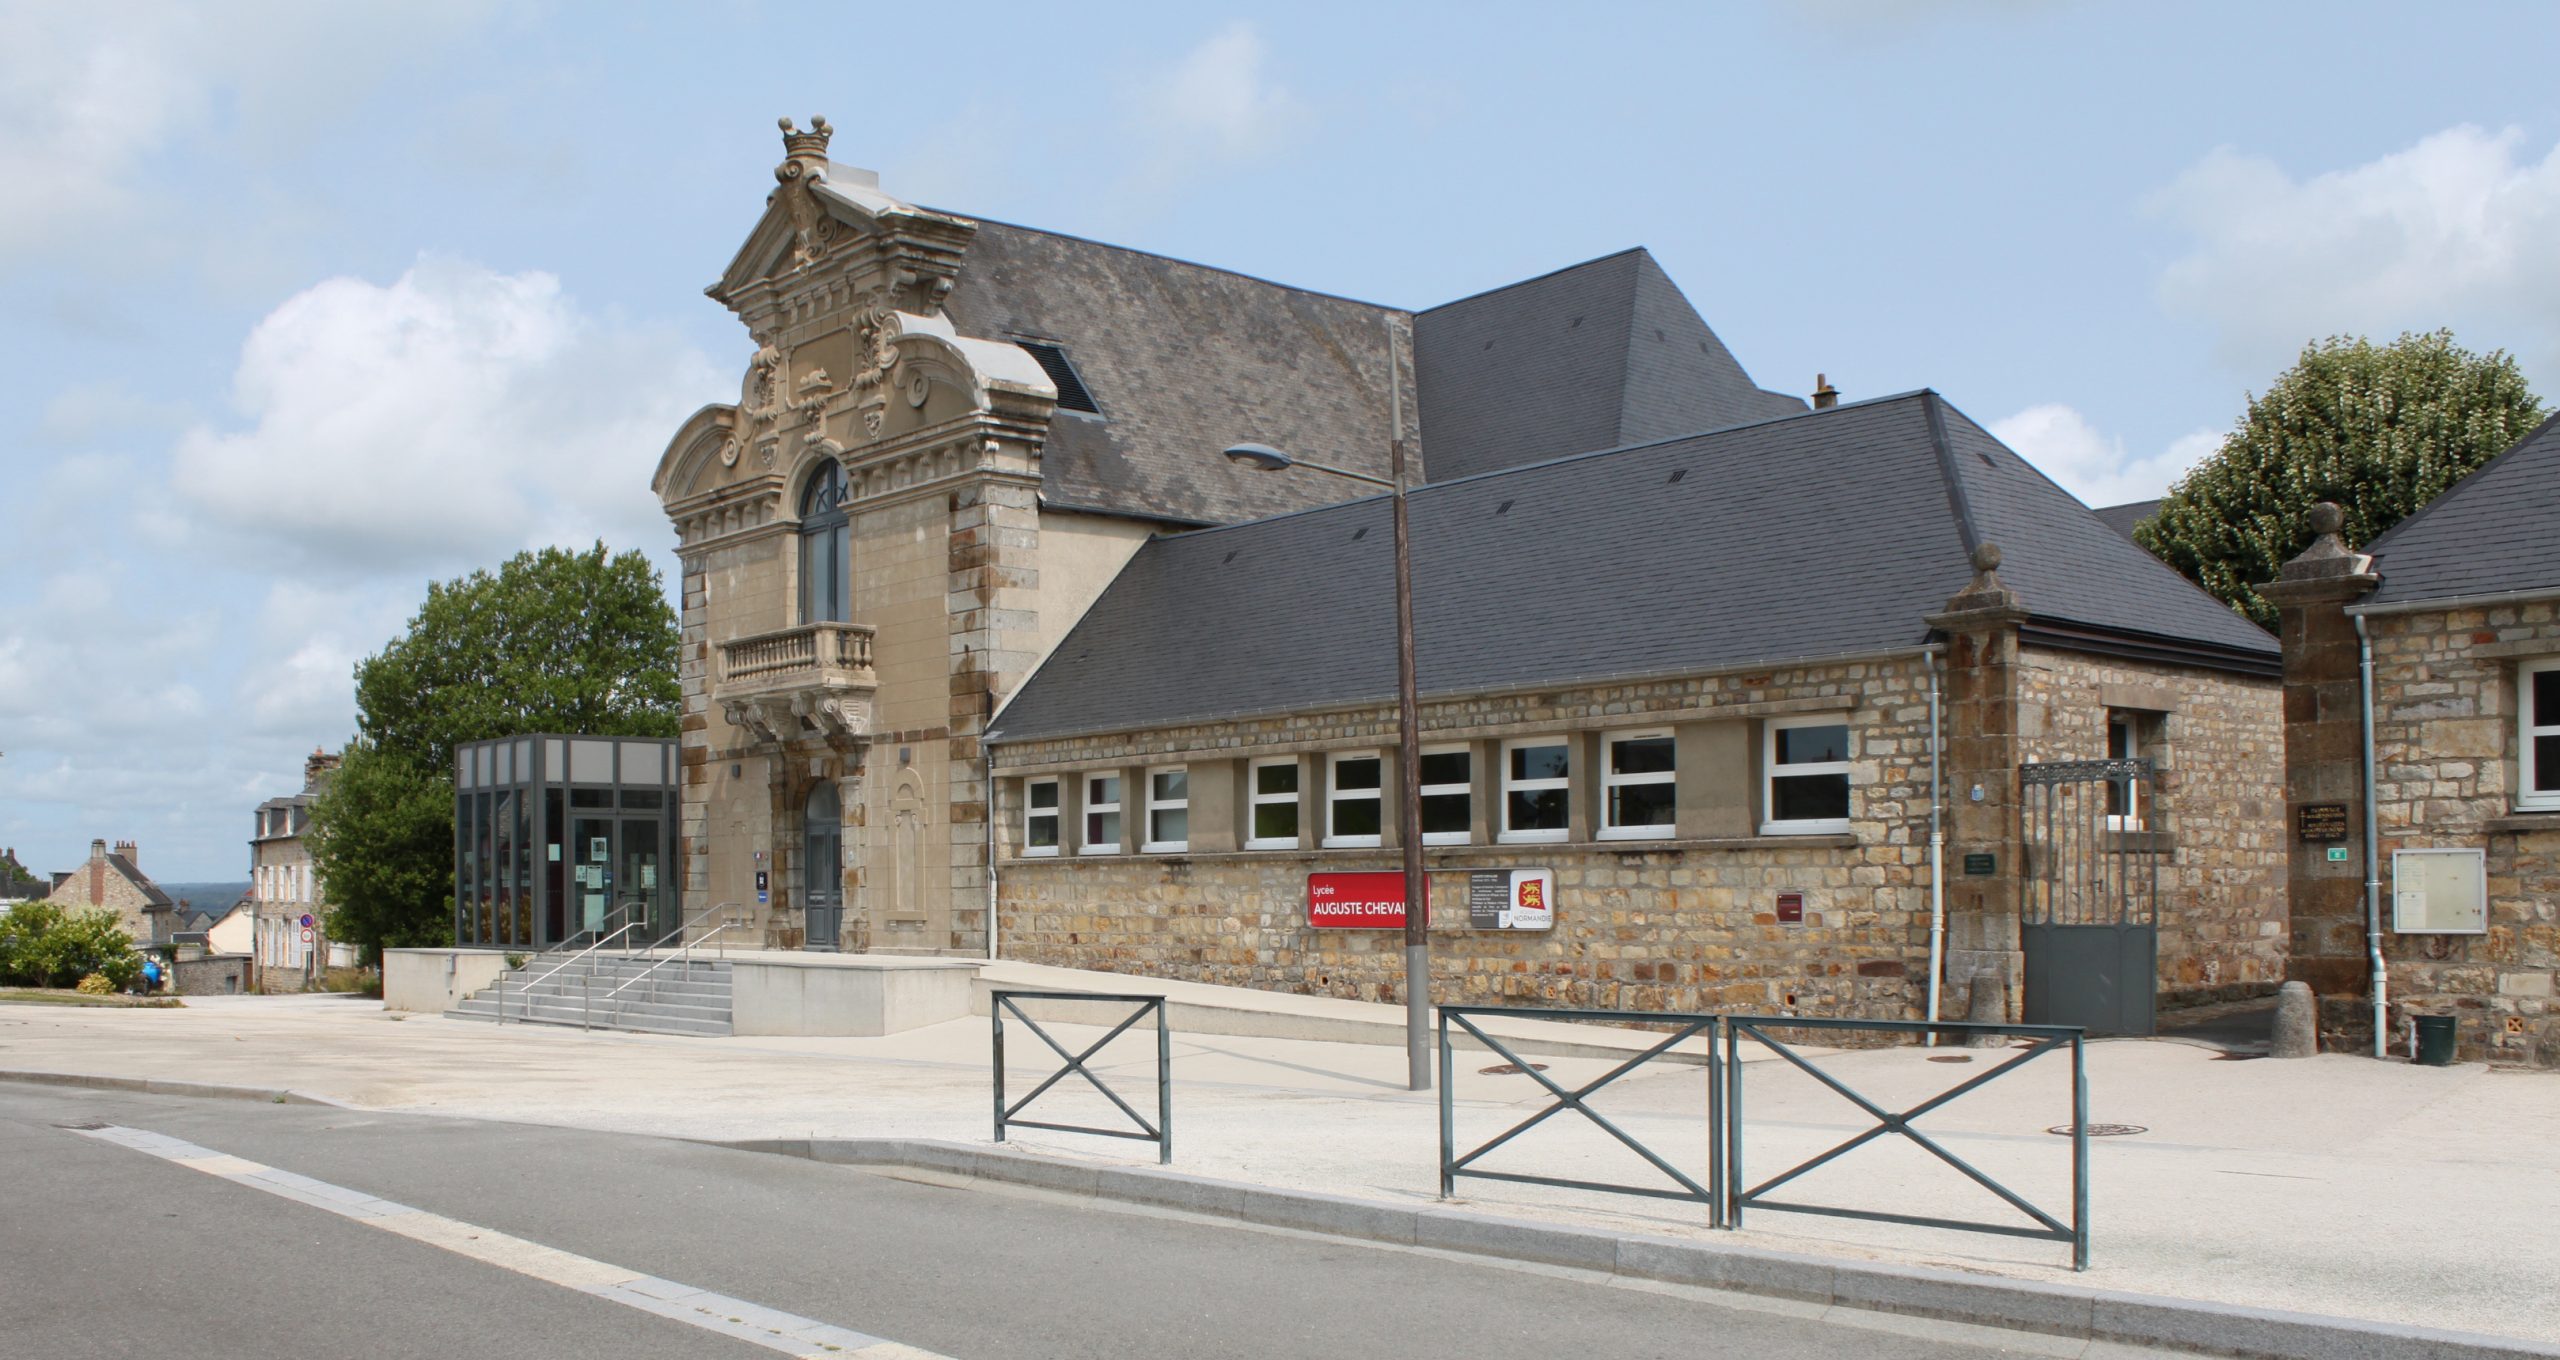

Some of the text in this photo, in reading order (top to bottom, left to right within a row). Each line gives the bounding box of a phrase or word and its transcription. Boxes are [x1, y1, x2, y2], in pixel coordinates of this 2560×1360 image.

[1313, 884, 1335, 898] Lycée
[1314, 902, 1363, 915] AUGUSTE
[1513, 914, 1553, 922] NORMANDIE
